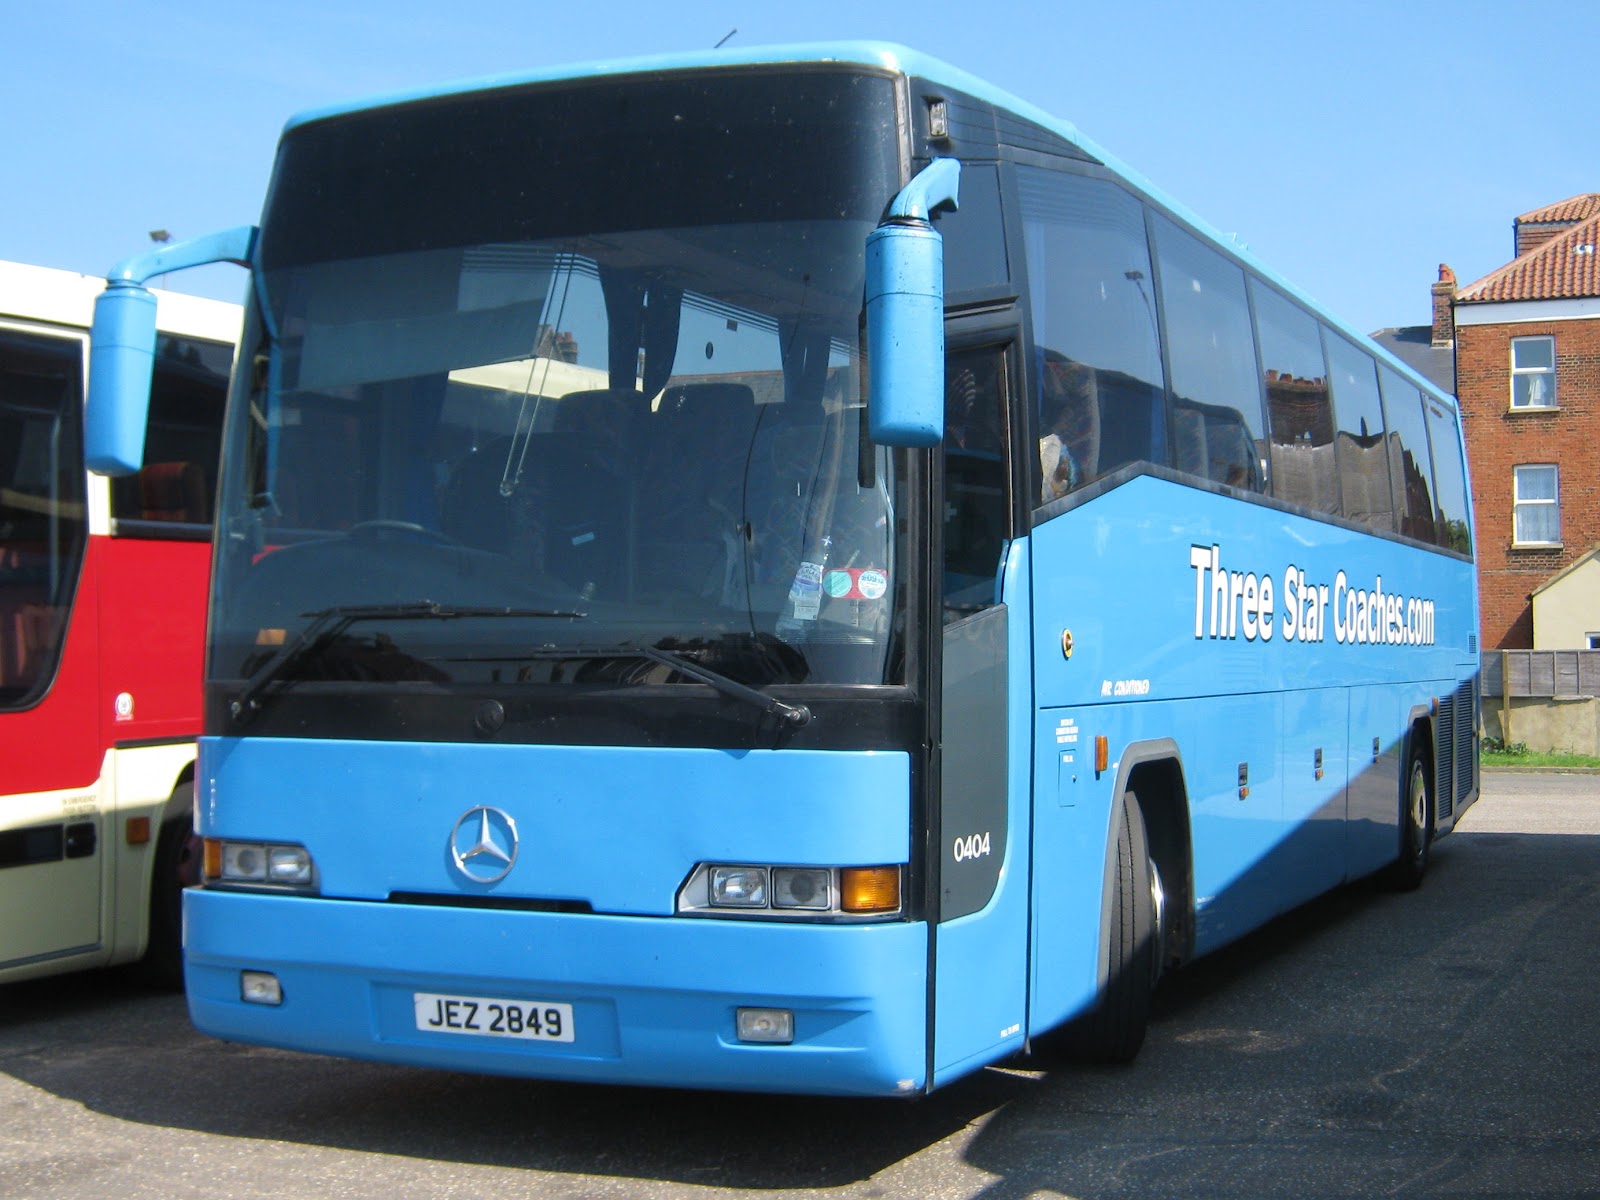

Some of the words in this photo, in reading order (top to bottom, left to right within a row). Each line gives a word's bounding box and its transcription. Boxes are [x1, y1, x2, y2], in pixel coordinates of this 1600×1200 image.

[1190, 543, 1274, 642] Three
[1282, 563, 1329, 643] Star
[1333, 568, 1436, 646] Coaches.com
[953, 831, 991, 863] 0404
[428, 999, 480, 1030] JEZ
[487, 1004, 562, 1037] 2849
